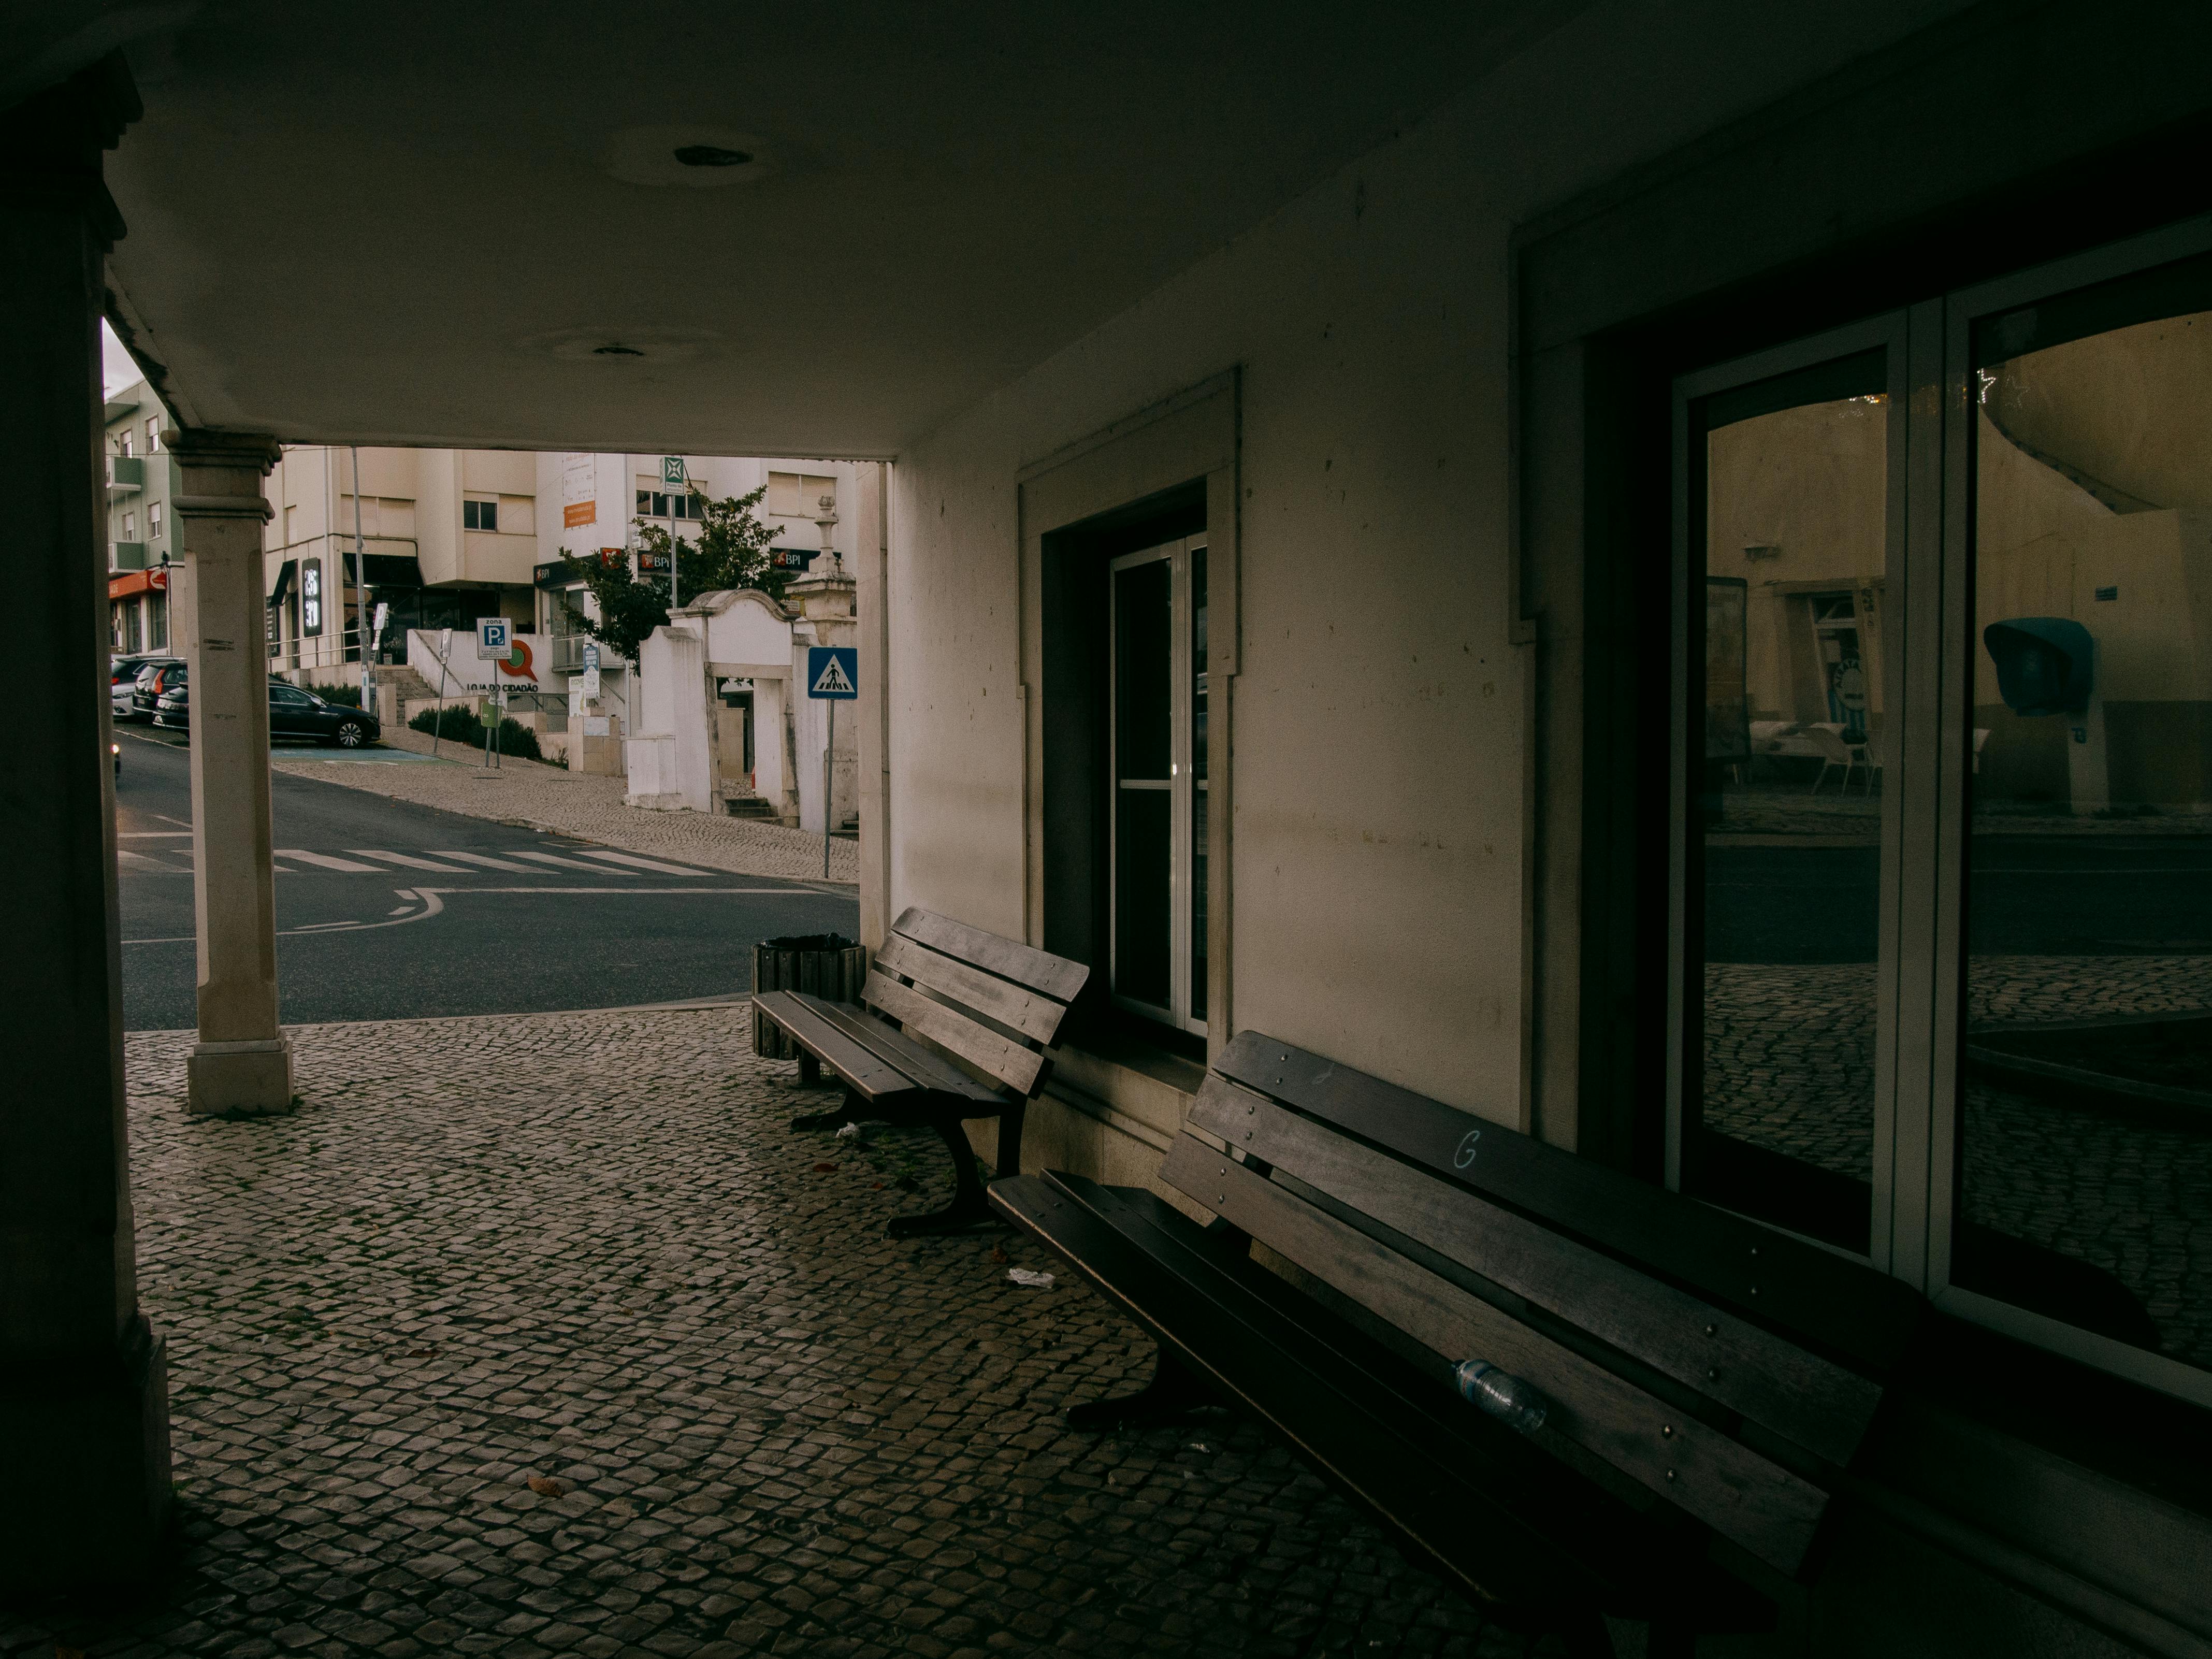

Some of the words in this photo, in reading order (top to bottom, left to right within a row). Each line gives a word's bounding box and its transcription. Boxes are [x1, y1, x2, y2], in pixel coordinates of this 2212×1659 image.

[654, 556, 669, 568] BPI
[786, 554, 800, 565] BPI
[488, 627, 501, 644] P
[489, 684, 501, 692] DO
[502, 683, 539, 693] CIDADÃO
[1454, 1130, 1480, 1168] G
